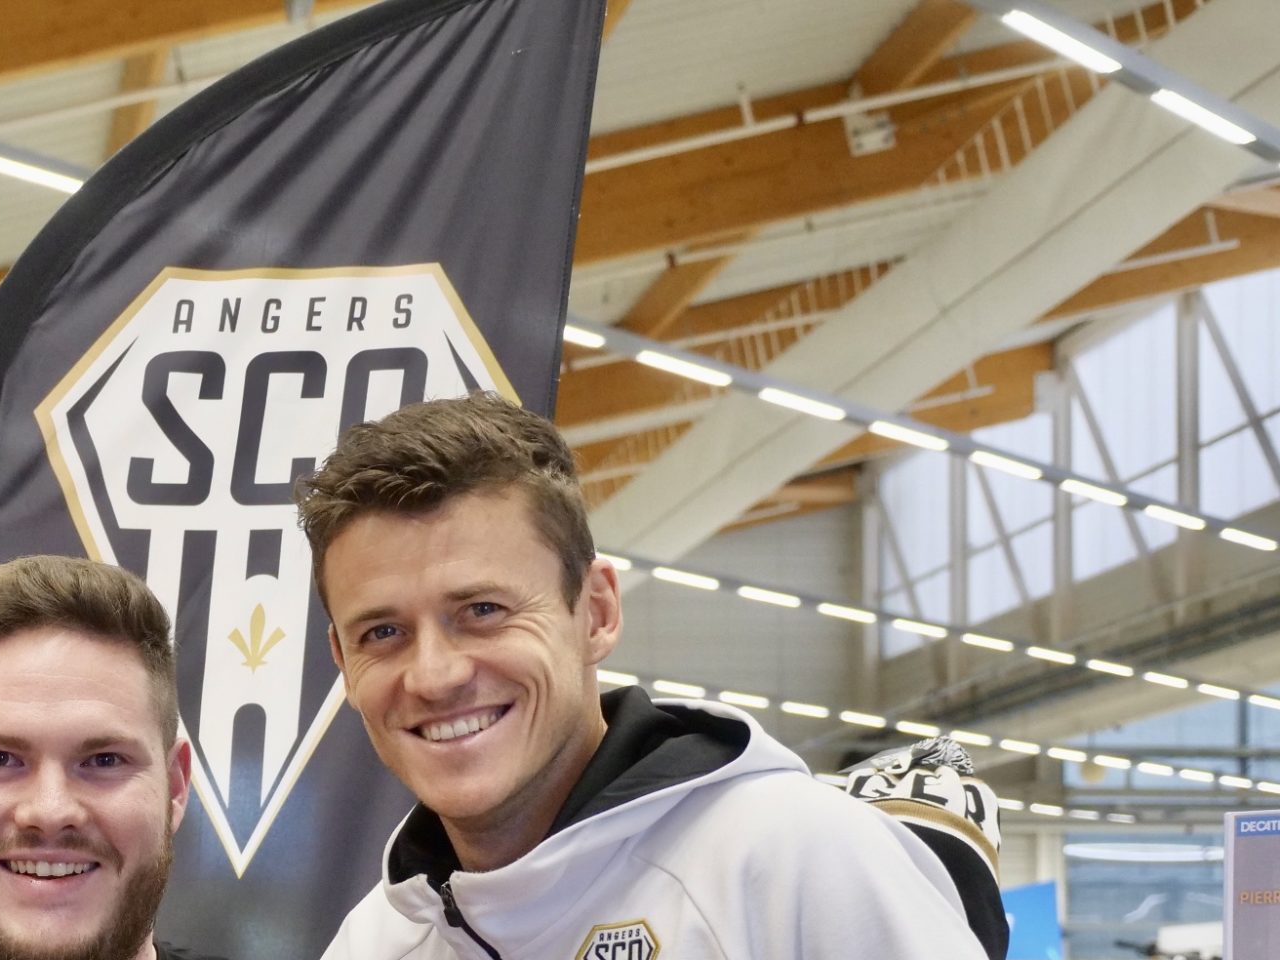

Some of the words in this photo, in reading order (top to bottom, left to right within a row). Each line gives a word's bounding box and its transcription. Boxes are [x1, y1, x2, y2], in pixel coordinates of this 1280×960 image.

[172, 294, 414, 334] ANGERS
[1240, 820, 1280, 832] DECAT
[599, 928, 640, 941] ANGERS
